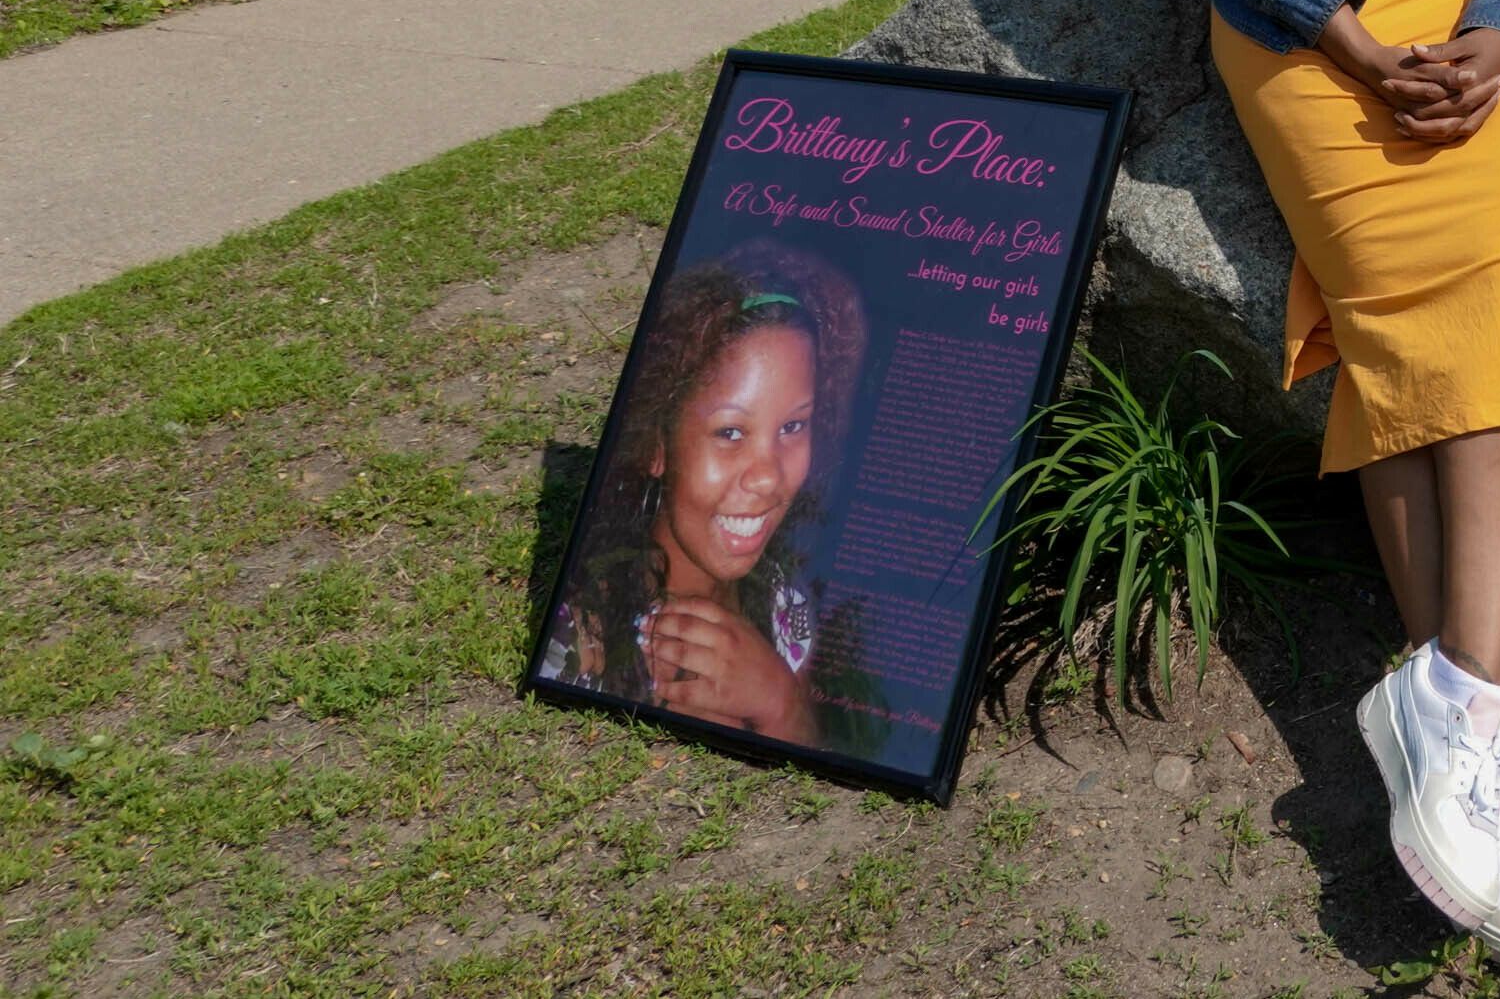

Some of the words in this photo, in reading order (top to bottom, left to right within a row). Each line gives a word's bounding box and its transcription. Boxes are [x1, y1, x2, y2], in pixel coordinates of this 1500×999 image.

[725, 98, 910, 183] Brittany's
[916, 118, 1056, 188] Place:
[724, 182, 754, 211] A
[750, 184, 798, 227] Safe
[800, 200, 838, 221] and
[834, 196, 906, 231] Sound
[904, 205, 976, 242] Shelter
[971, 221, 1007, 256] for
[1004, 220, 1064, 262] Girls
[972, 275, 1001, 290] our
[1005, 276, 1040, 298] girls
[988, 302, 1009, 326] be
[1014, 311, 1049, 334] girls
